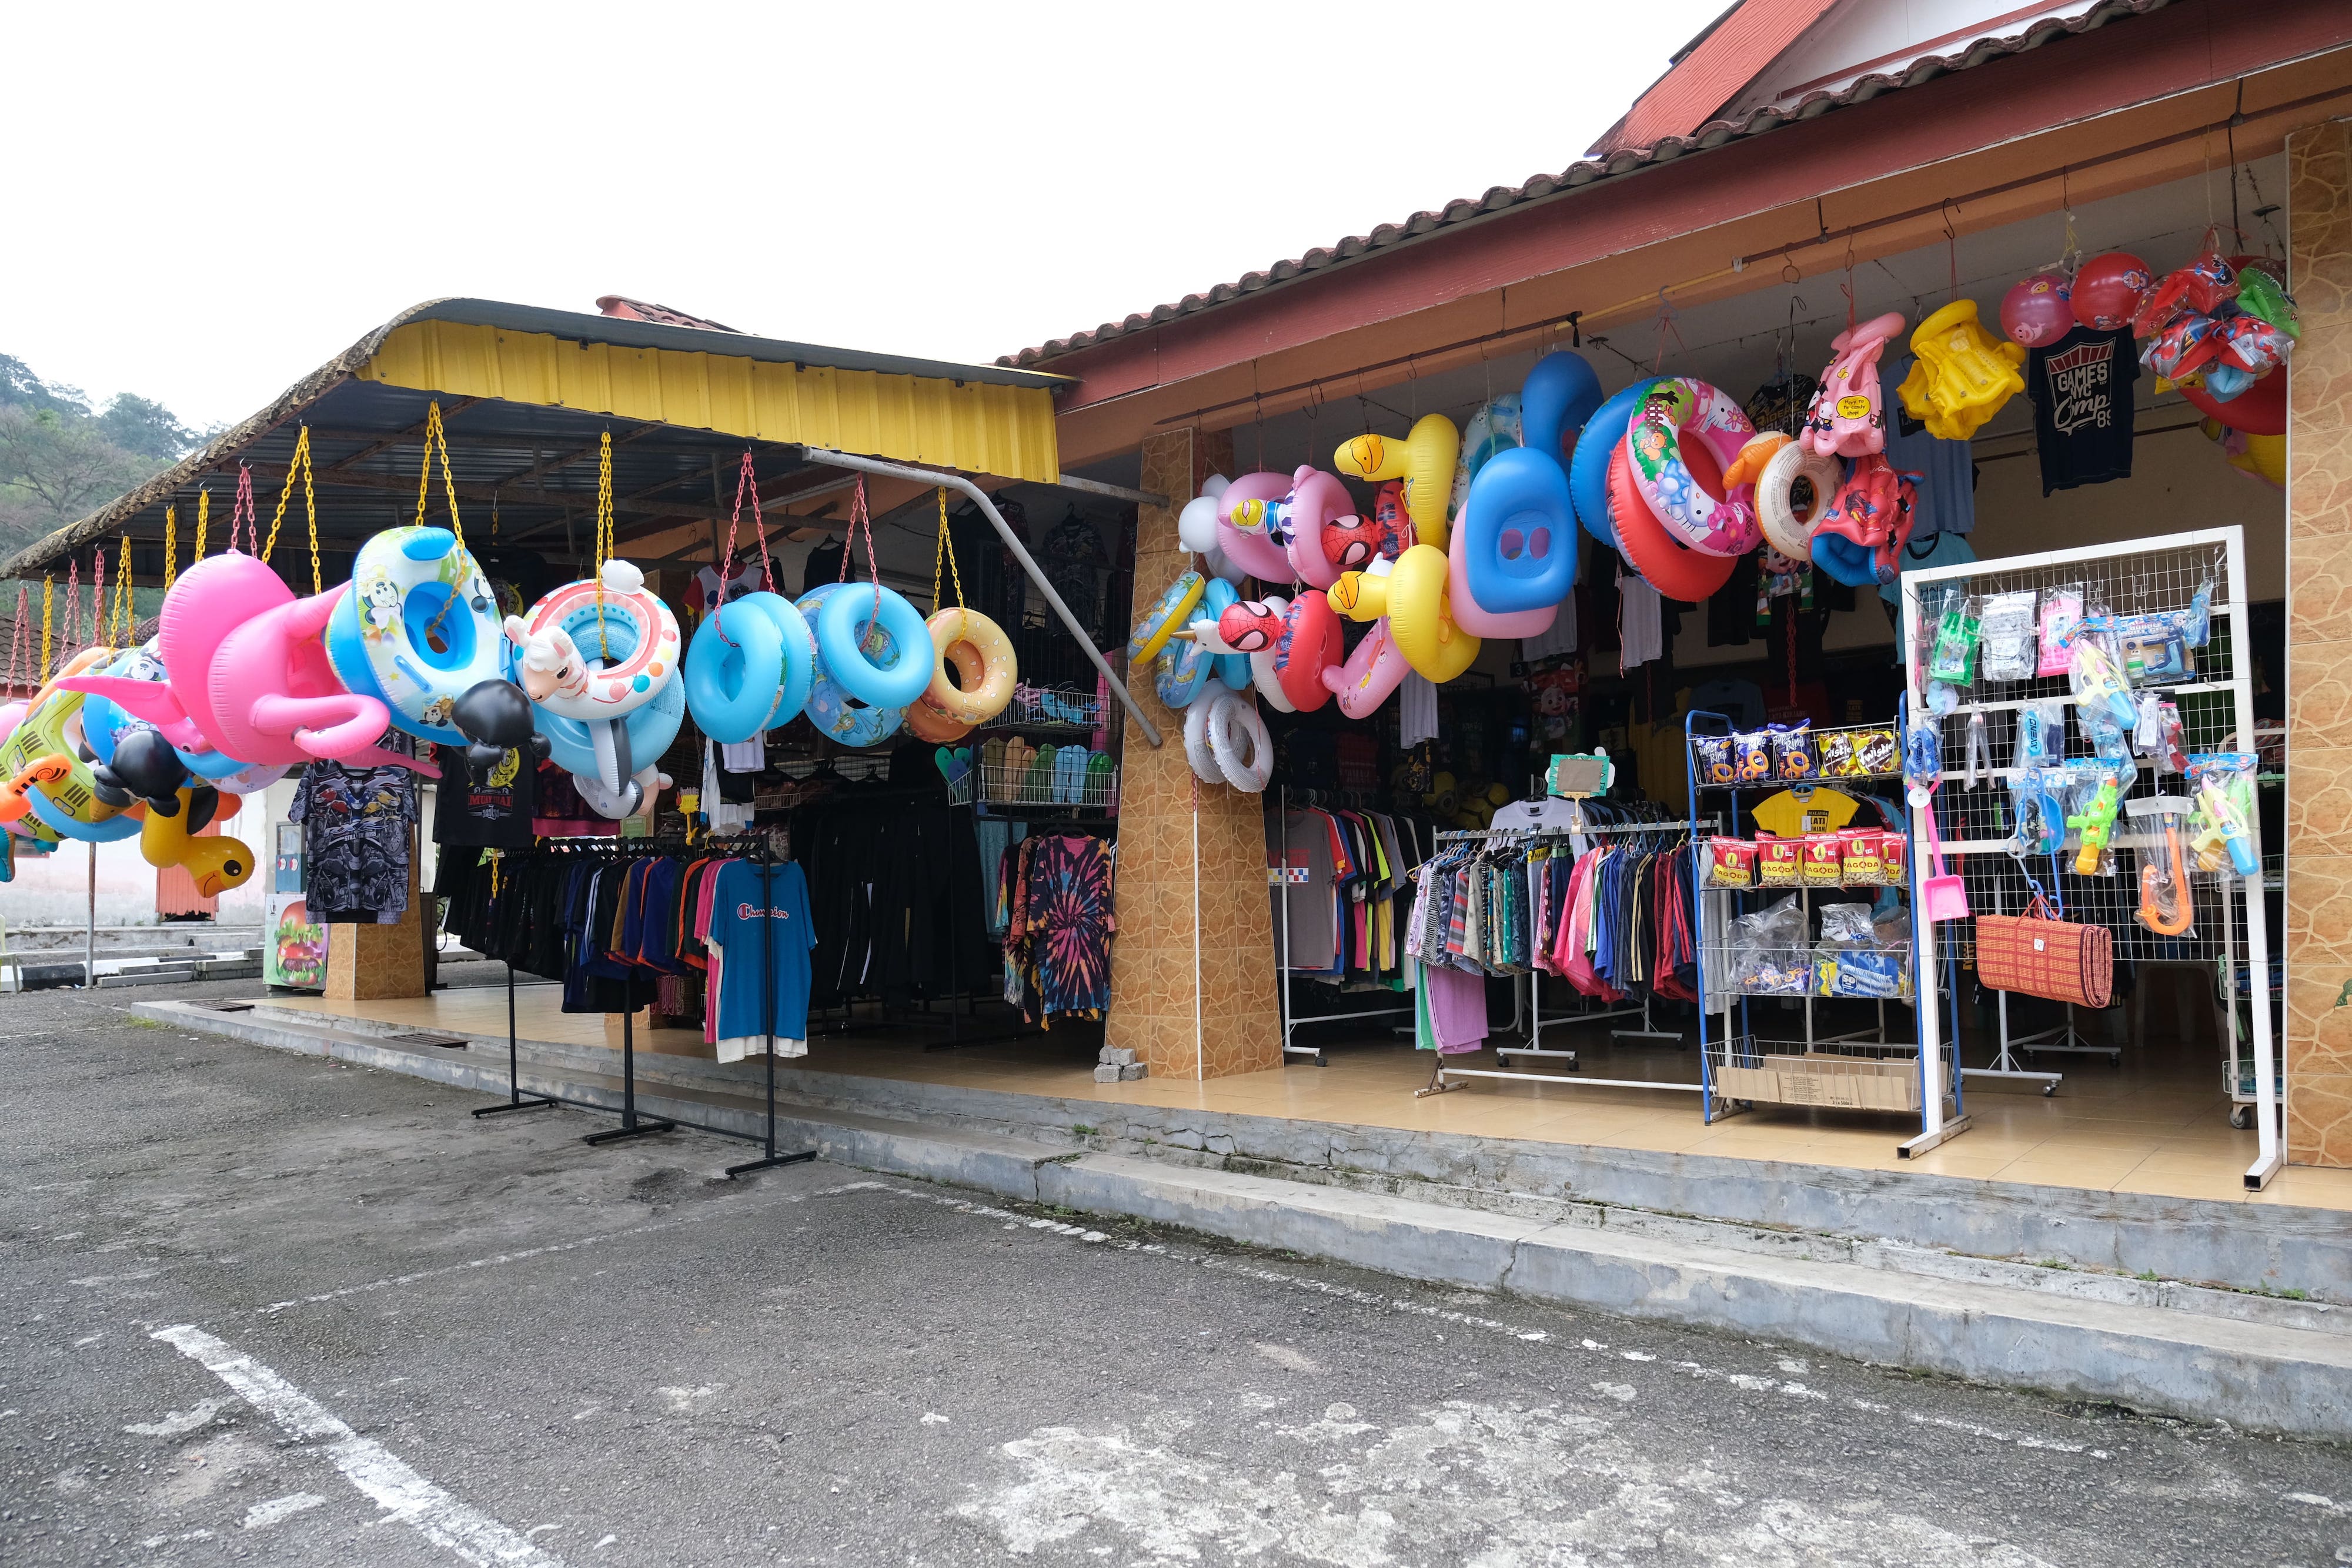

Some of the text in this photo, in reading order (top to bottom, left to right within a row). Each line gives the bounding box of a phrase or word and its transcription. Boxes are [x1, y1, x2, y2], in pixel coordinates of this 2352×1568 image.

[2058, 362, 2107, 392] GAMES
[2070, 383, 2092, 399] NYC
[1856, 742, 1893, 764] Twistie
[1715, 867, 1749, 880] PAGODA
[1805, 865, 1840, 874] PAGODA
[737, 903, 789, 920] Chamion
